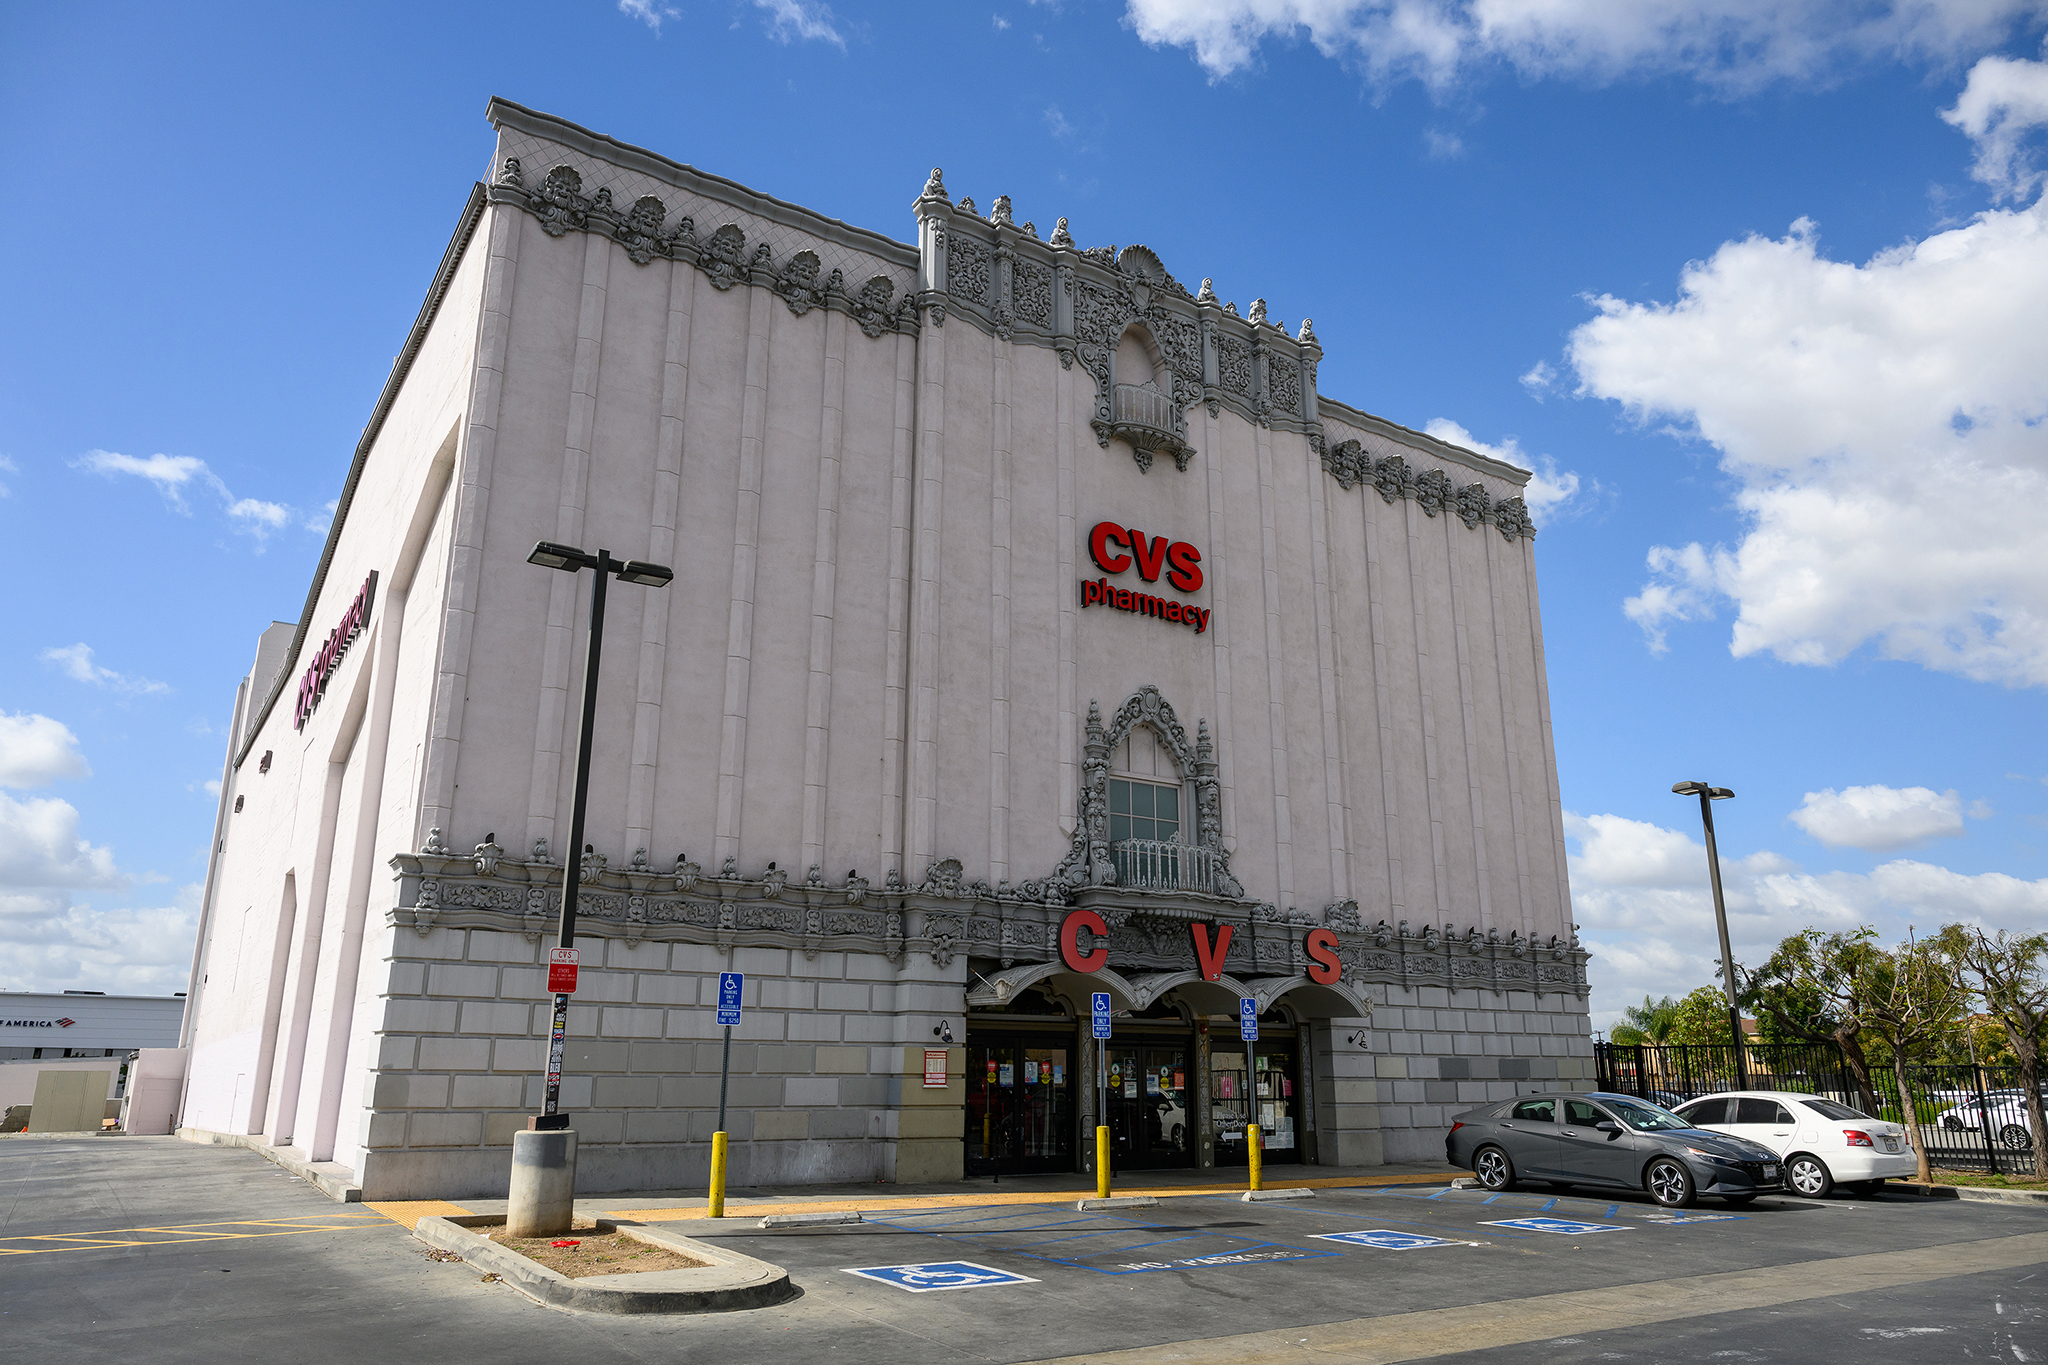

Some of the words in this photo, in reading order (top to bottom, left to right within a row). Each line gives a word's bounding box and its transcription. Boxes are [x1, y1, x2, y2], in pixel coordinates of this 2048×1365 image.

[1088, 522, 1203, 593] CVS
[1081, 577, 1210, 634] pharmacy
[294, 651, 321, 730] CVS
[558, 951, 572, 959] CVS
[1257, 1060, 1262, 1068] A
[1216, 1111, 1234, 1119] Please
[1216, 1119, 1233, 1127] Other
